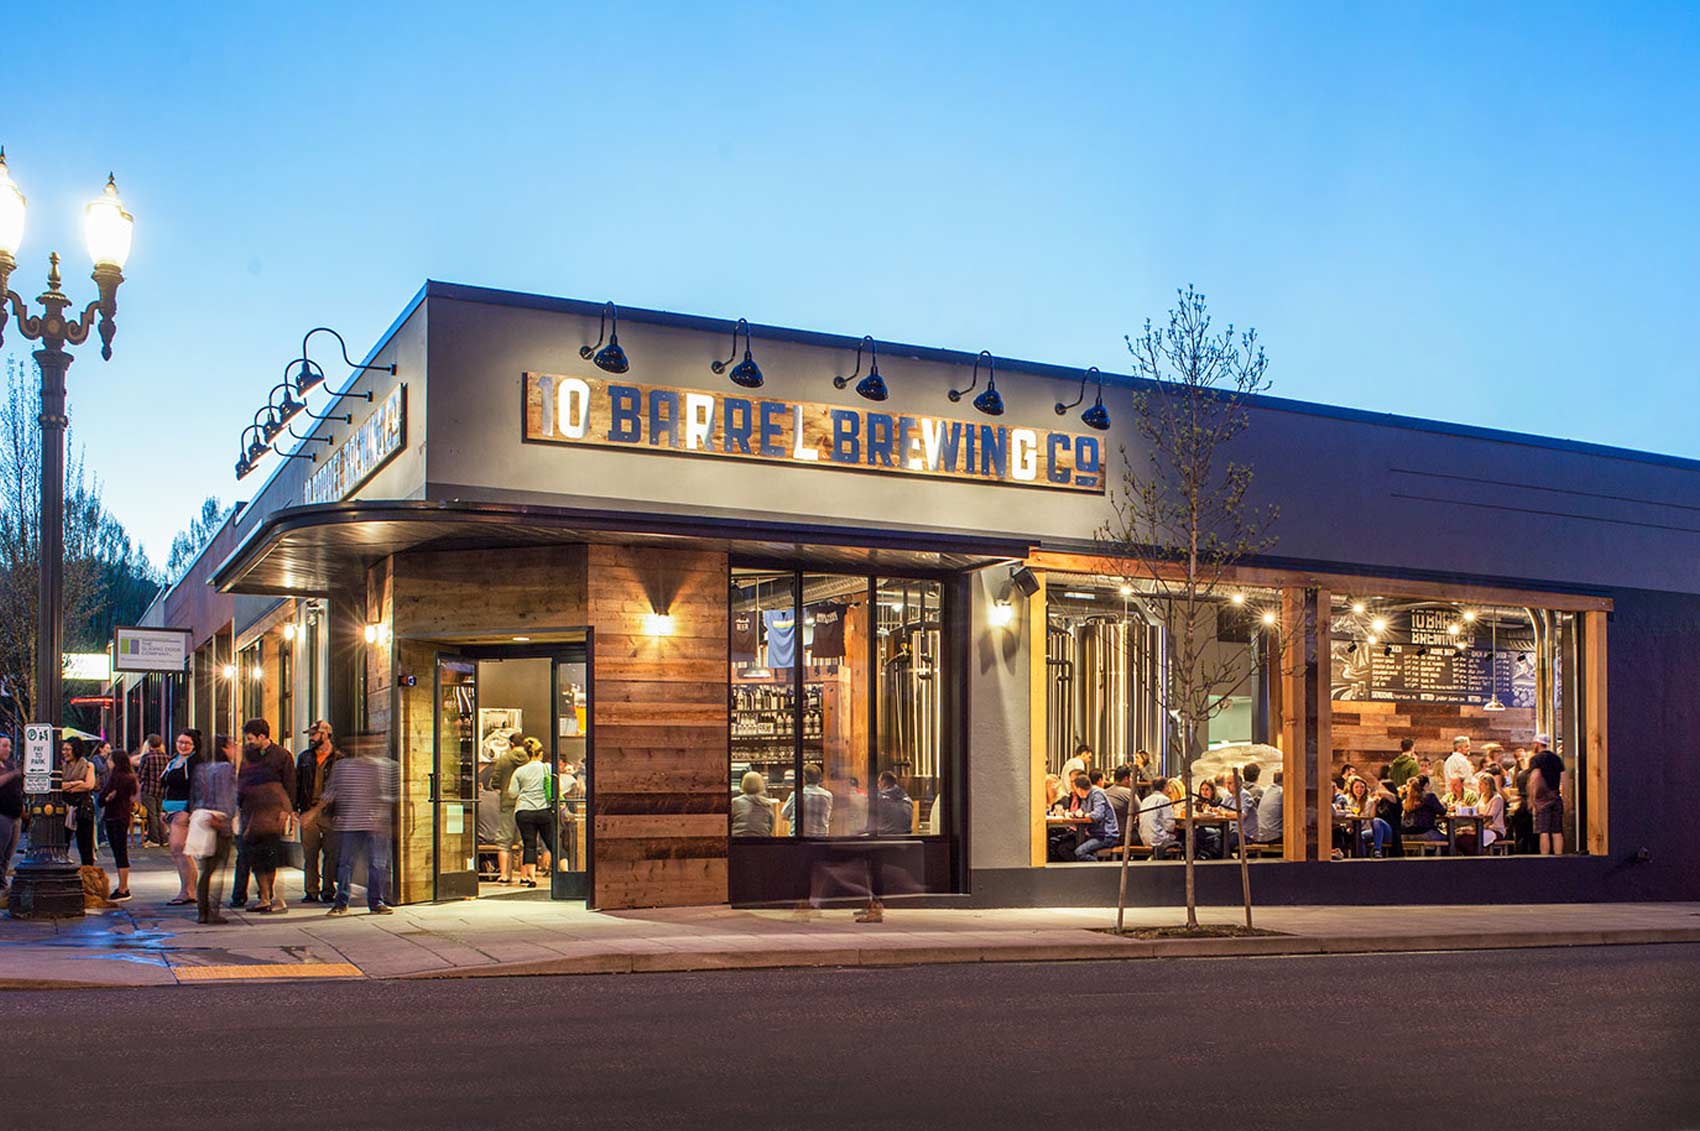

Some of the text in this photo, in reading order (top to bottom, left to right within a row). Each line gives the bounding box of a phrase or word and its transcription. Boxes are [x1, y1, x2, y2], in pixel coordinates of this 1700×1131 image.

[537, 375, 590, 439] 10
[608, 384, 819, 461] BARREL
[830, 408, 1037, 481] BREWING
